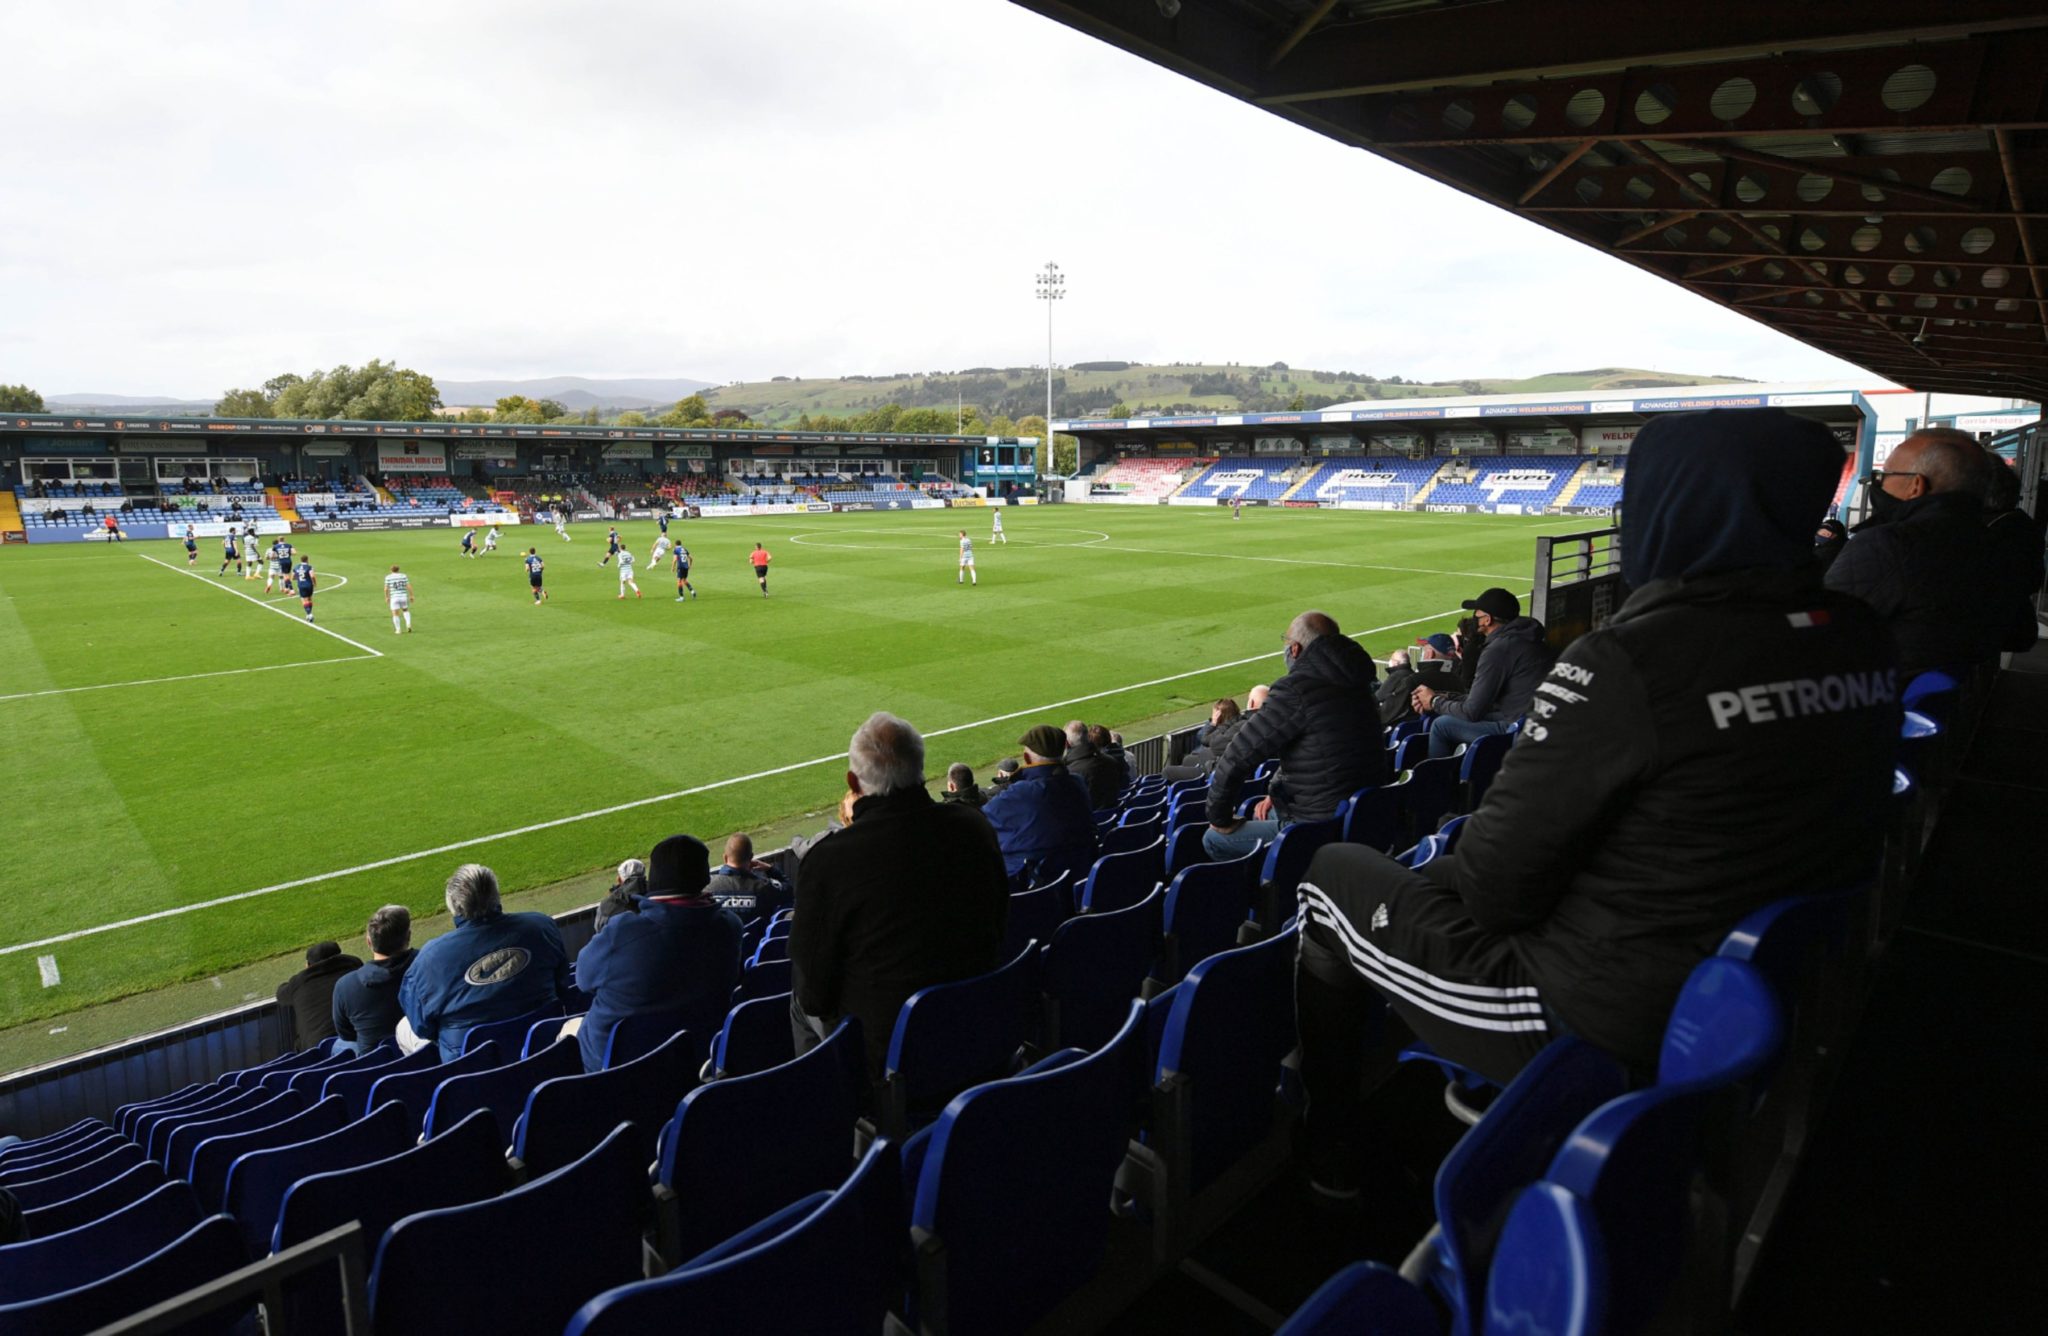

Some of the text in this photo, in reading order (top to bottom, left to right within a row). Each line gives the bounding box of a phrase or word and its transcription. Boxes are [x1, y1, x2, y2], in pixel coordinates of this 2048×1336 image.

[1680, 400, 1714, 408] WELDING
[1716, 398, 1760, 406] SOLUTIONS
[1990, 416, 2024, 424] Motors
[381, 456, 444, 465] THERMAL HIRE LTD
[1425, 504, 1467, 513] macron
[278, 549, 289, 558] 25
[299, 572, 305, 581] 2
